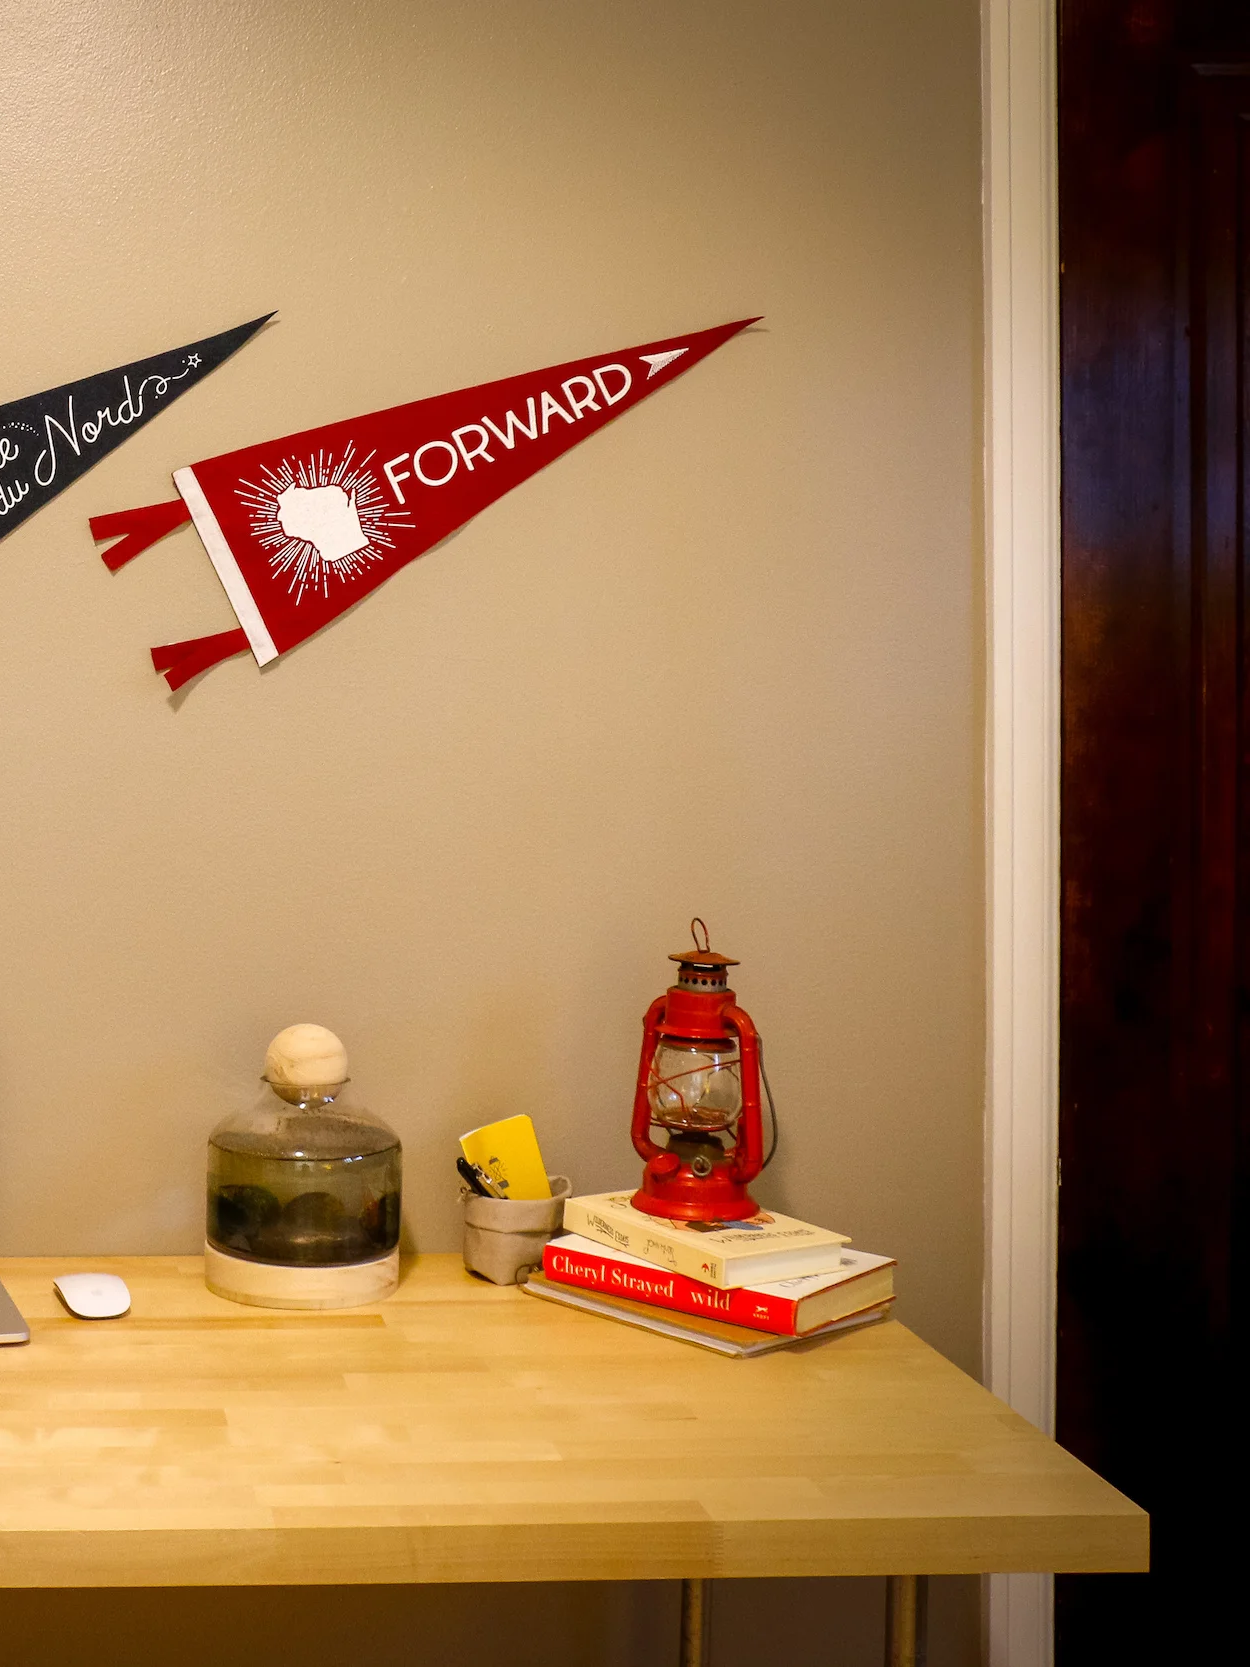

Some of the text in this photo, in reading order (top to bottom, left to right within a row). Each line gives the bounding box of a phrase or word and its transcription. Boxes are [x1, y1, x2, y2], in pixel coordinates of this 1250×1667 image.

[34, 375, 144, 487] Nord
[382, 363, 634, 504] FORWARD
[552, 1255, 730, 1311] Cheryl Strayed wild
